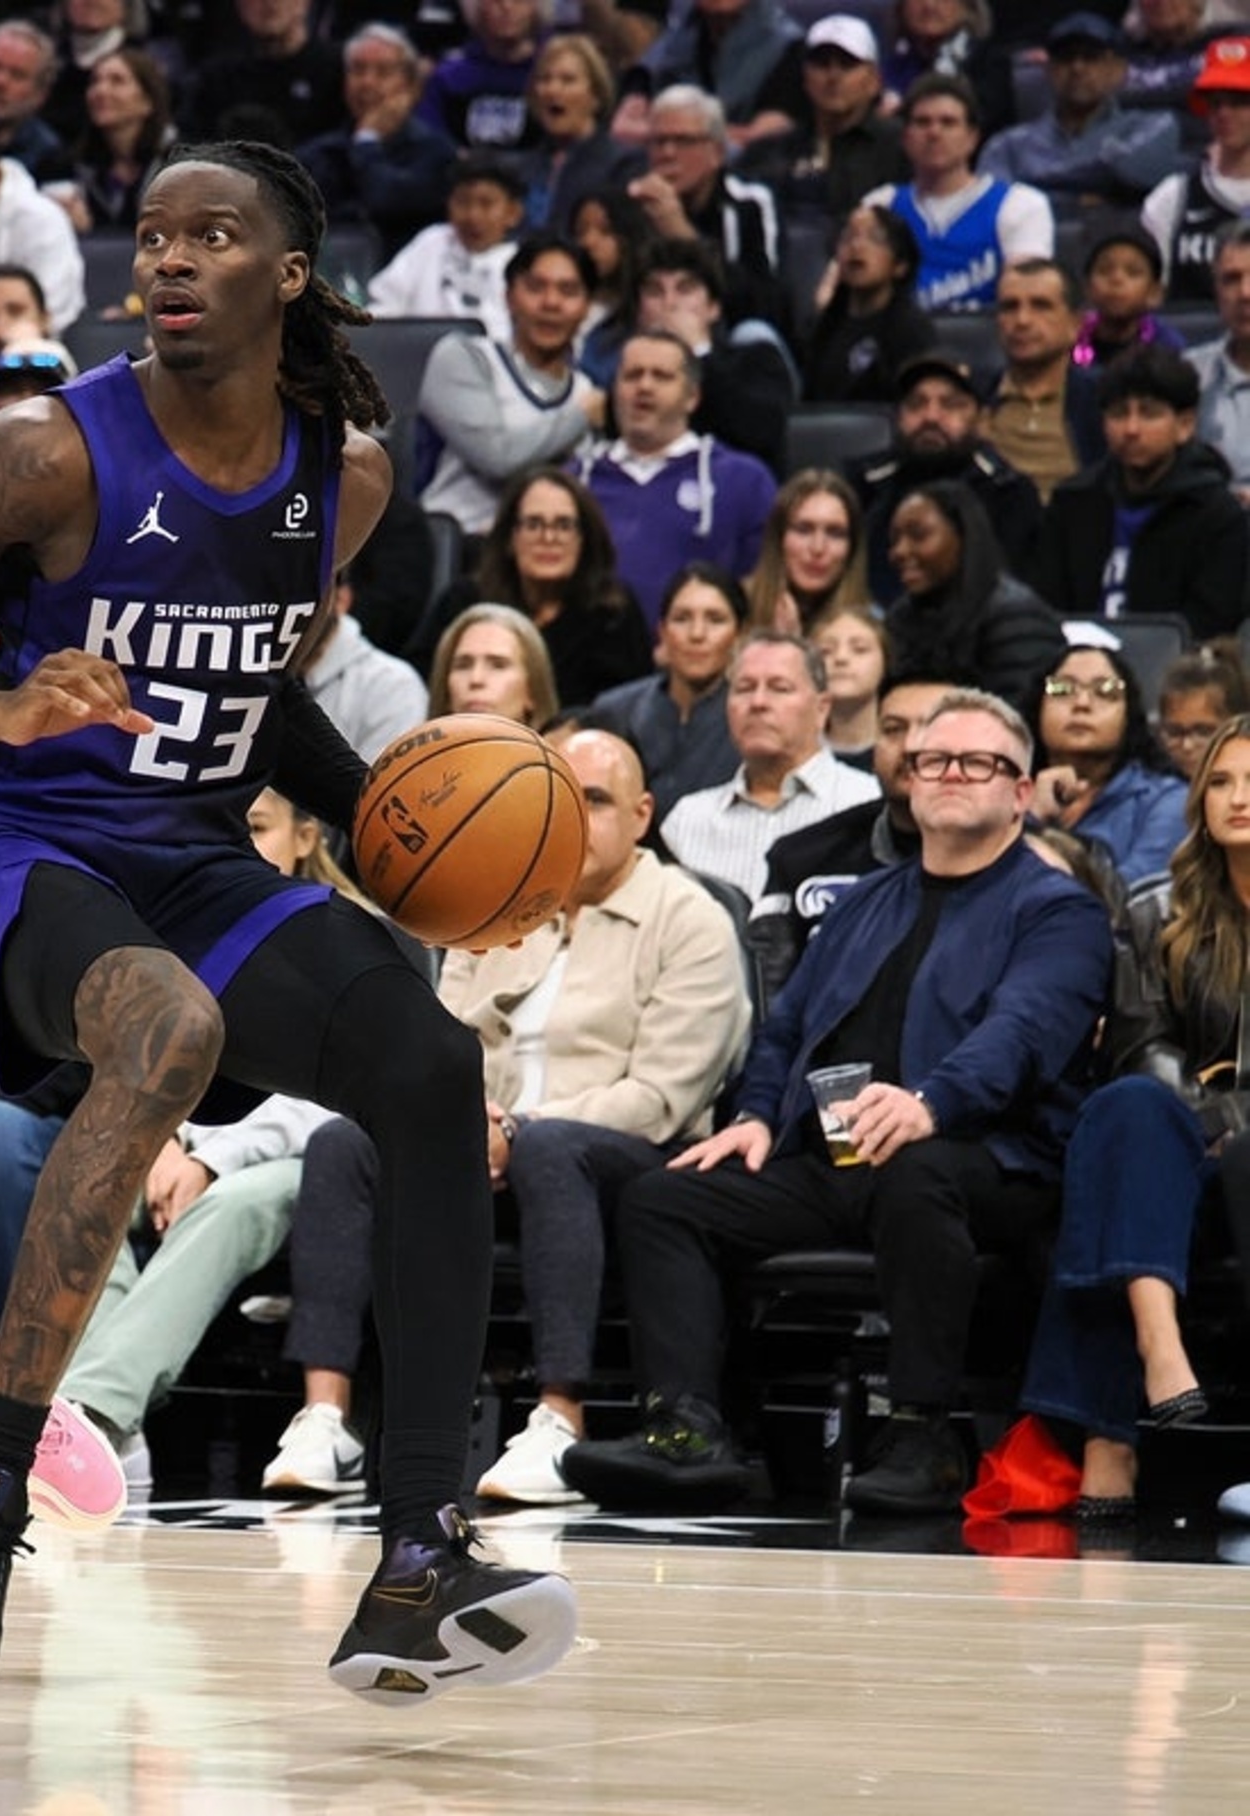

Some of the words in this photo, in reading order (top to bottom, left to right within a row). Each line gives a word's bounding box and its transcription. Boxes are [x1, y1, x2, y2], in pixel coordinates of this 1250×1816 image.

[84, 597, 316, 673] KINGS
[154, 603, 280, 620] SACRAMENTO
[129, 681, 269, 782] 23
